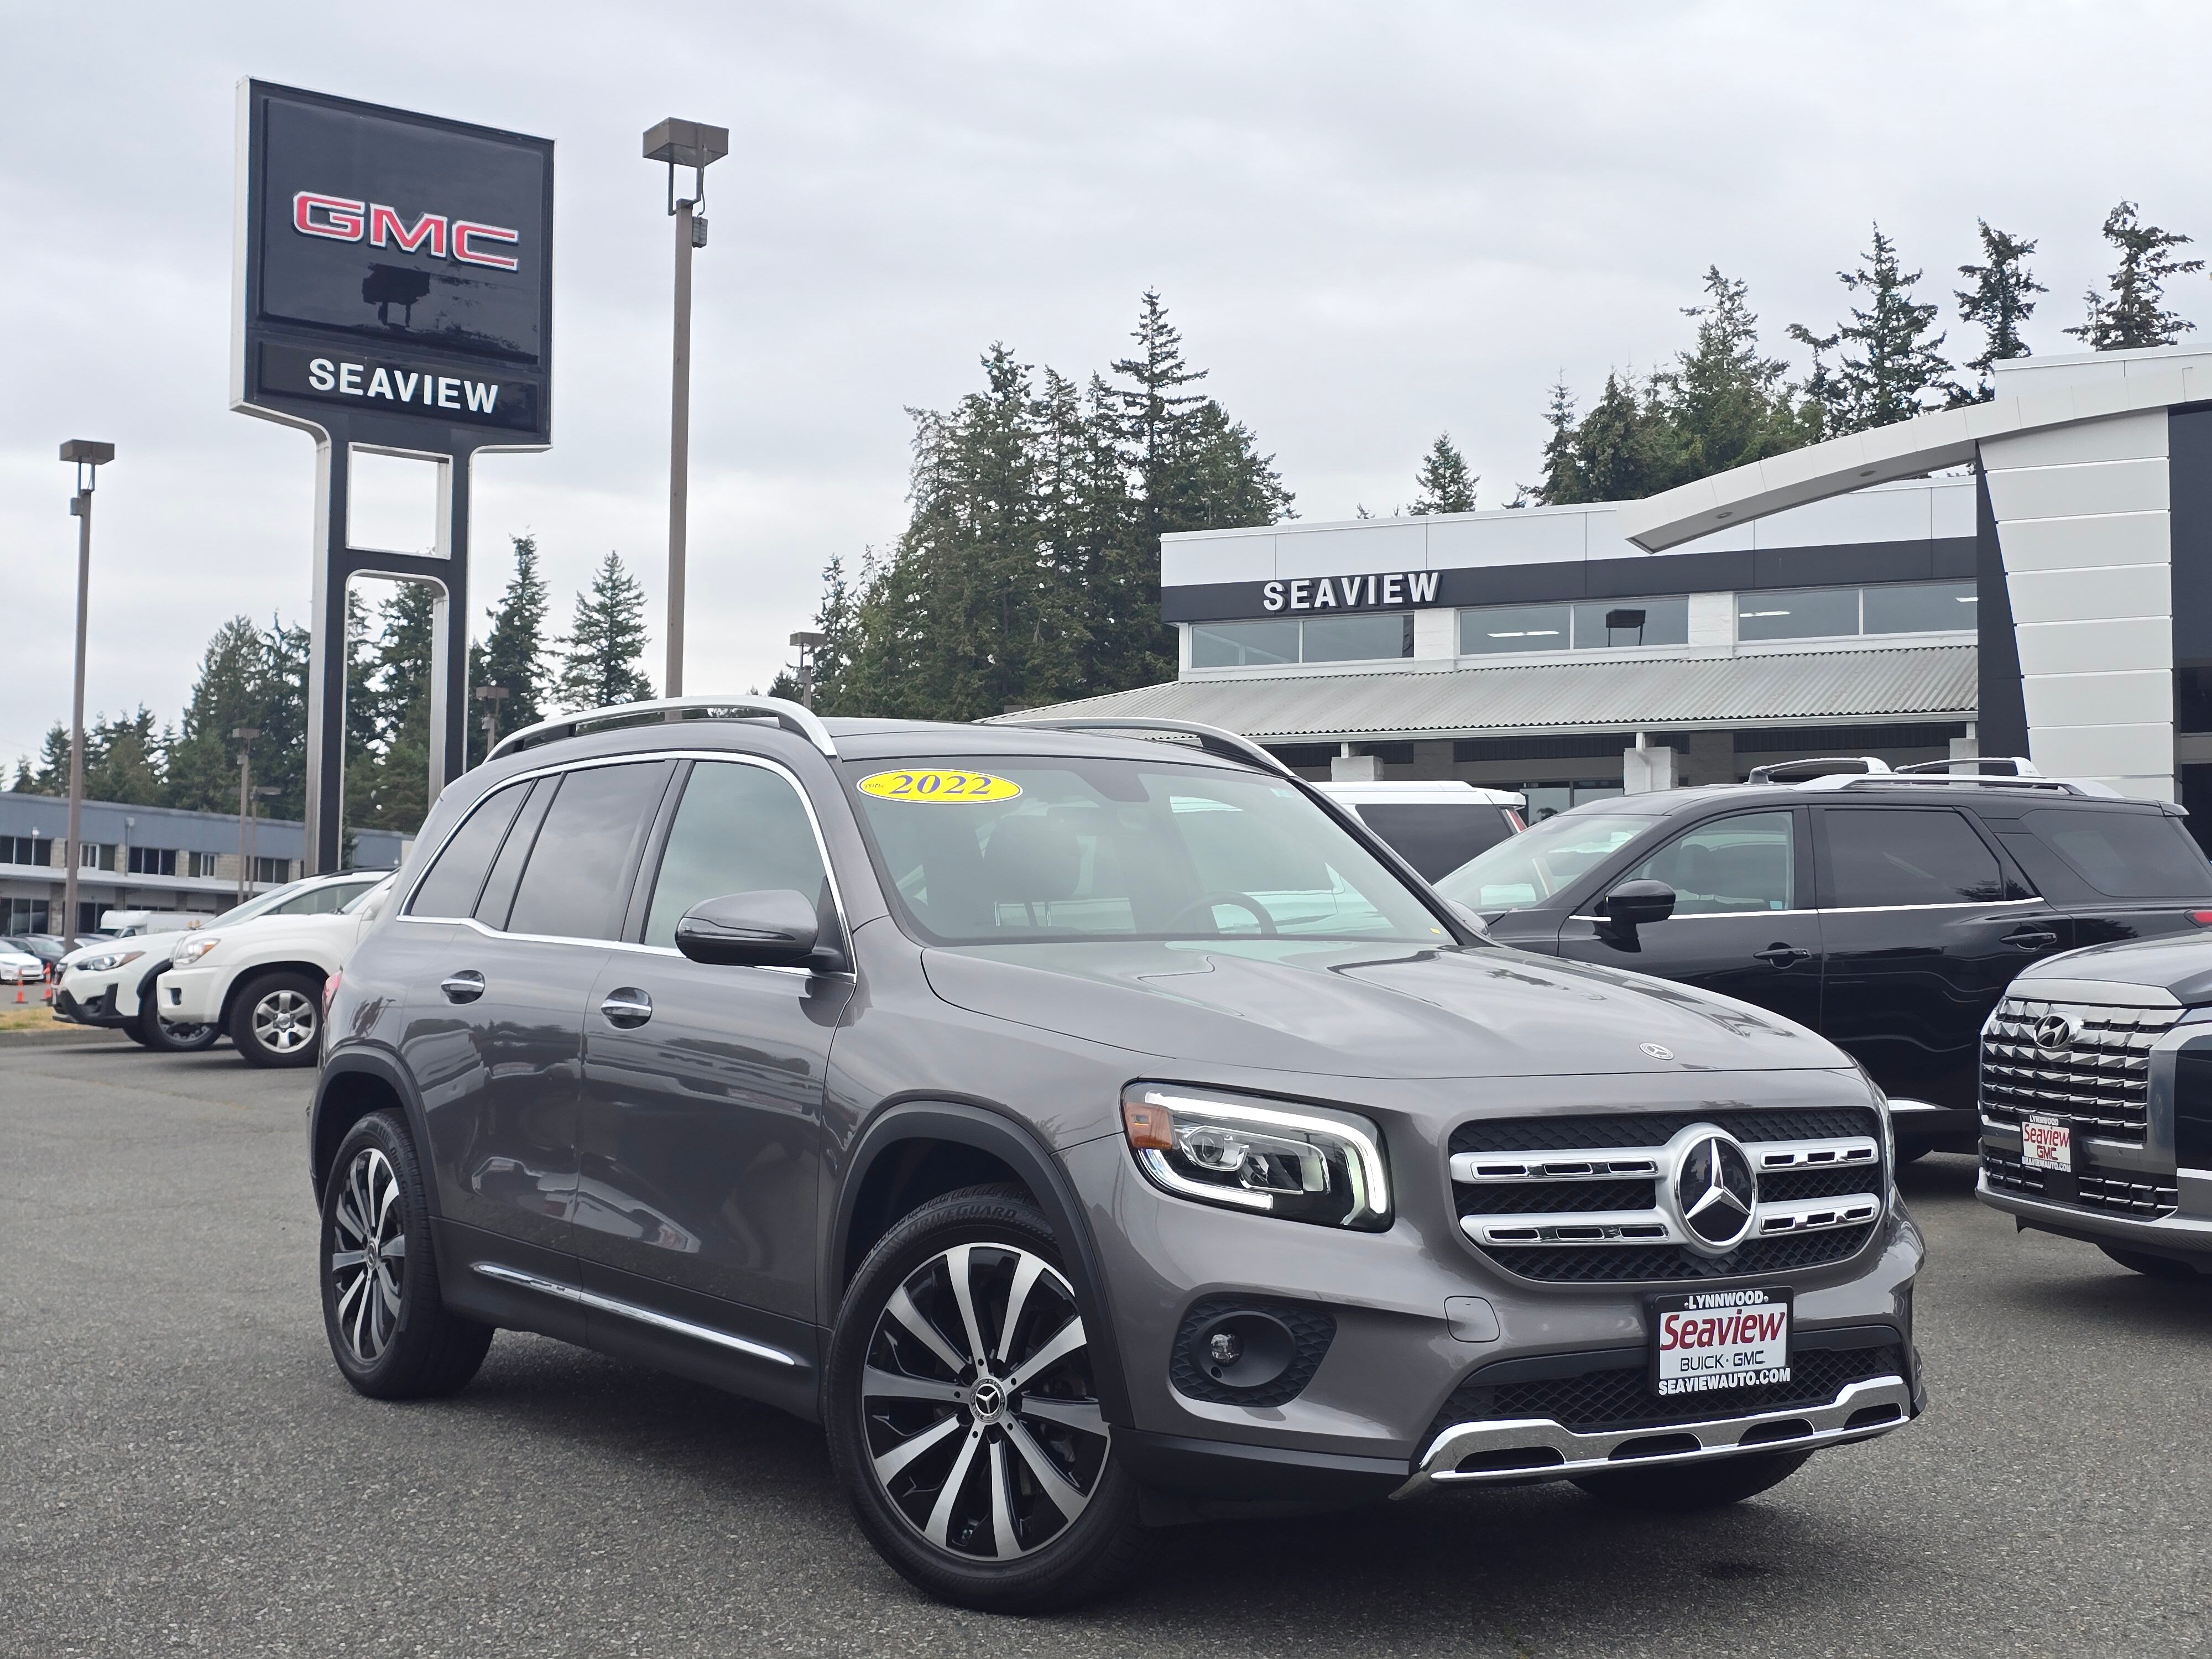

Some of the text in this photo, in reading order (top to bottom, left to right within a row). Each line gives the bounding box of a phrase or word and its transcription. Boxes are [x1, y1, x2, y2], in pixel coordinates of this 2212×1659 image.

[293, 191, 519, 272] GMC
[309, 358, 498, 414] SEAVIEW
[1263, 572, 1439, 611] SEAVIEW
[888, 774, 992, 795] 2022
[2030, 1114, 2059, 1126] LYNNWOOD
[2024, 1123, 2070, 1148] Seaview
[2037, 1145, 2058, 1161] GMC
[1688, 1290, 1764, 1310] LYNNWOOD
[1660, 1308, 1786, 1351] Seaview
[1680, 1350, 1766, 1372] BUICK GMC
[1658, 1368, 1791, 1396] SEAVIEWAUTO.COM
